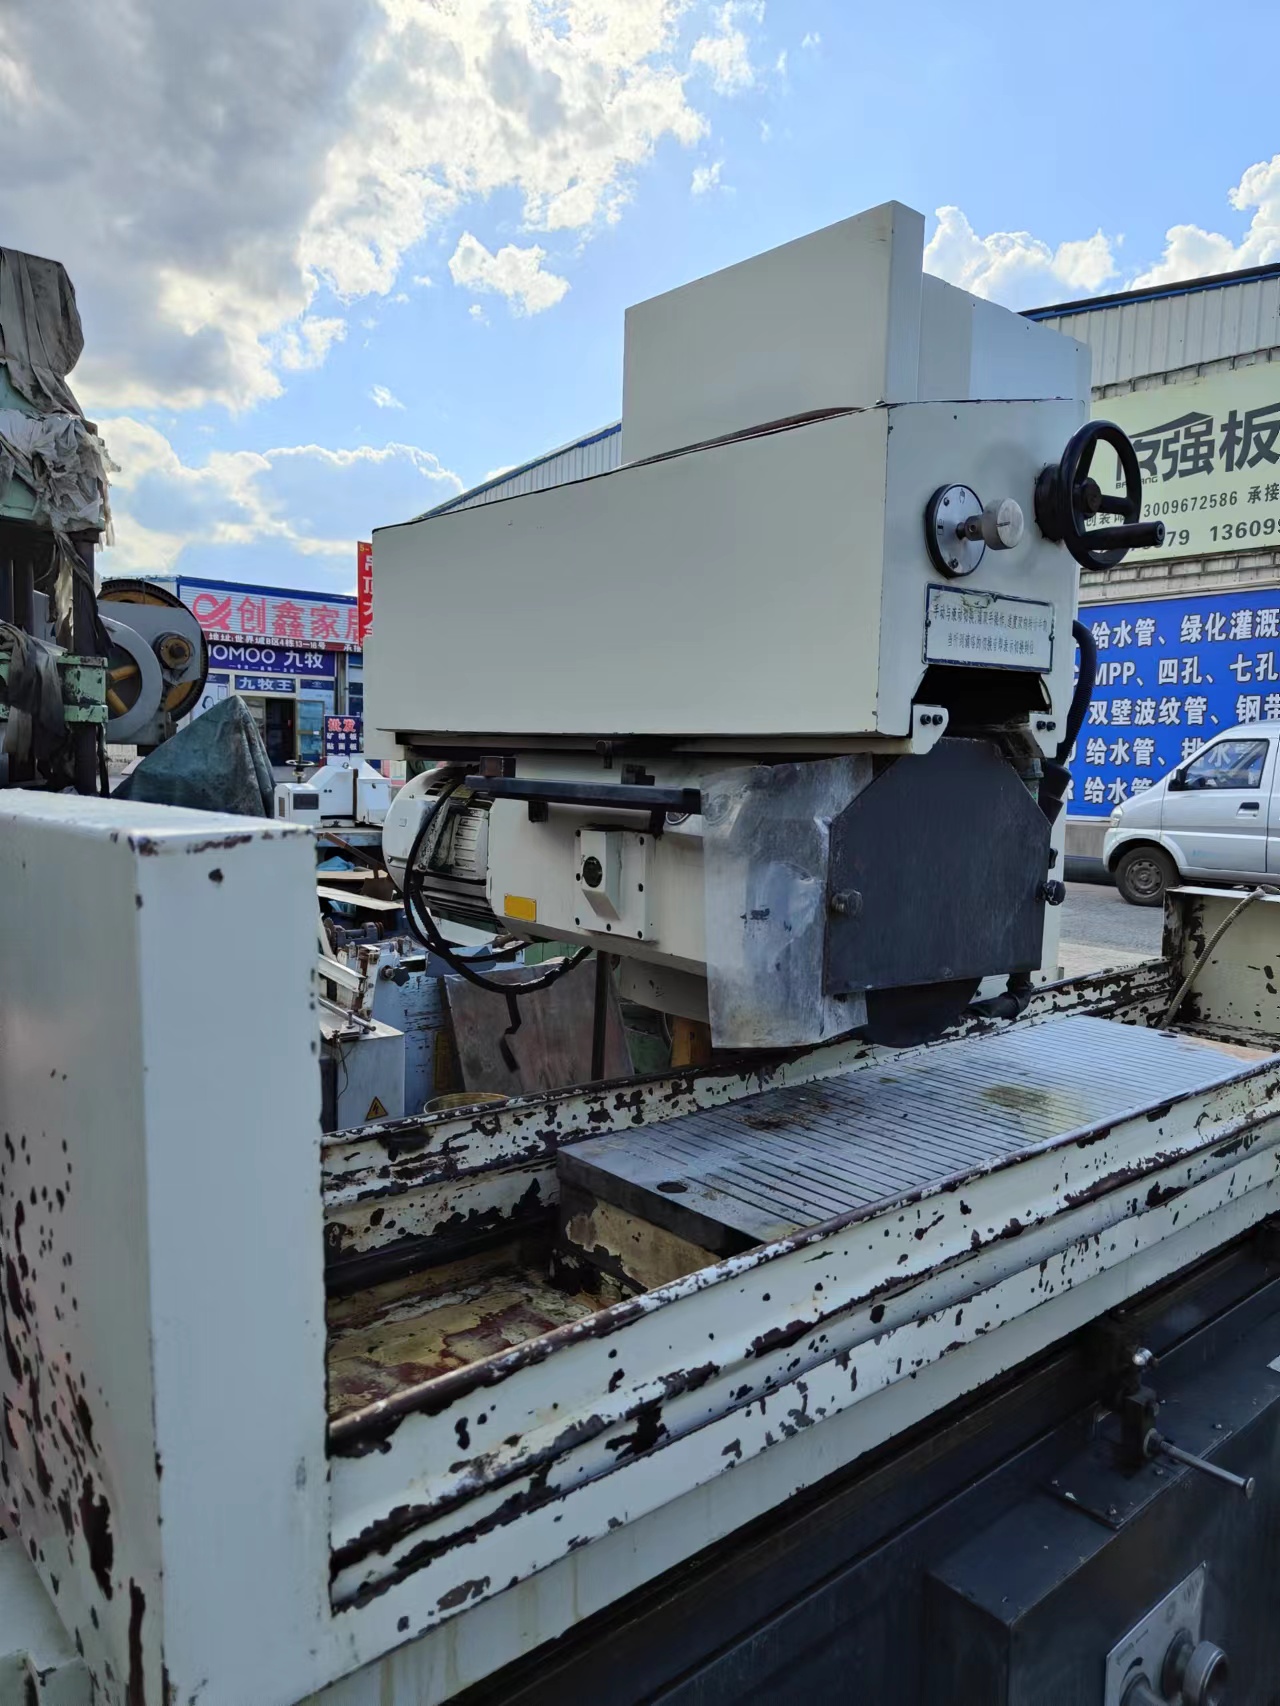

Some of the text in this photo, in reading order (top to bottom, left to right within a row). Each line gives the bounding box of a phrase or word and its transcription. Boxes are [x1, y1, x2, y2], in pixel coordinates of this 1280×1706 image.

[1143, 491, 1238, 518] 3009672586
[1209, 518, 1280, 542] 13609
[284, 650, 324, 669] 九牧
[240, 677, 293, 692] 九牧王
